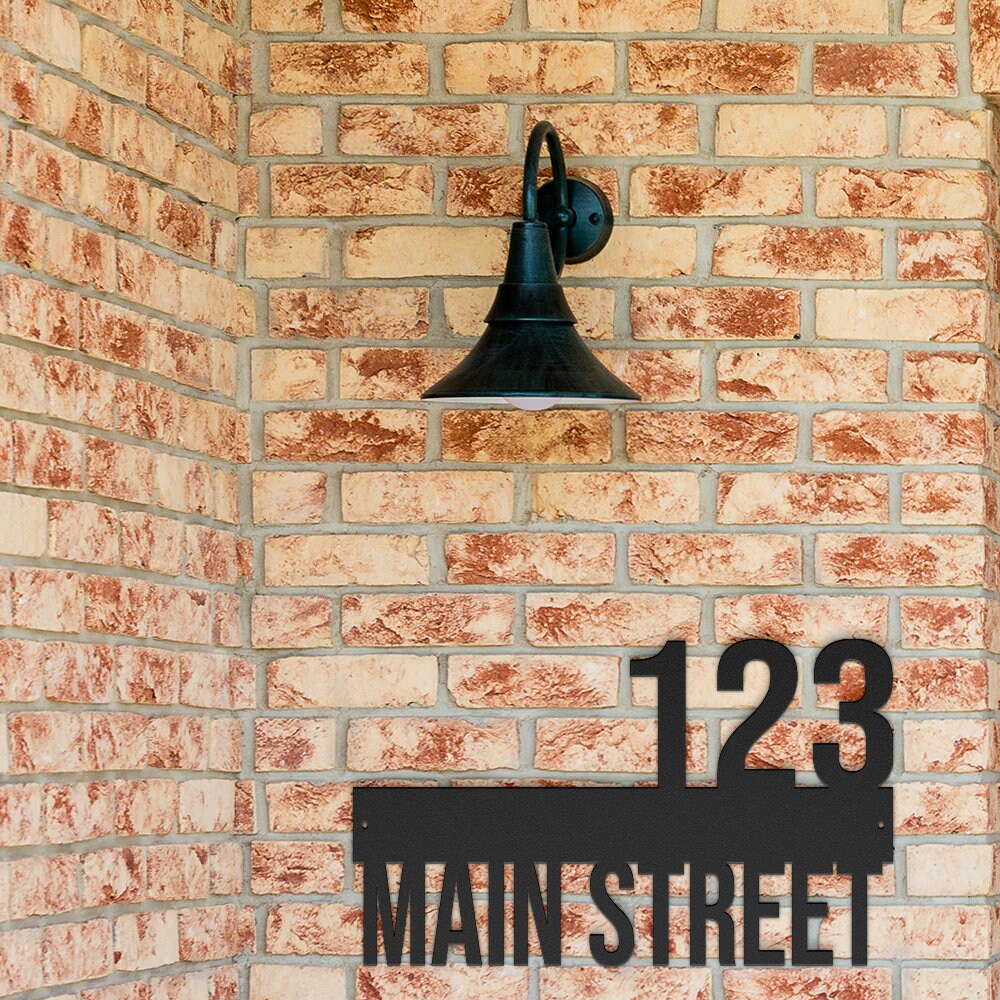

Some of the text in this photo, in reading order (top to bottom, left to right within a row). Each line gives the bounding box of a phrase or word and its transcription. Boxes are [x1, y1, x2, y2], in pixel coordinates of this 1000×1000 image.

[630, 639, 894, 788] 123
[363, 862, 883, 967] MAIN STREET
